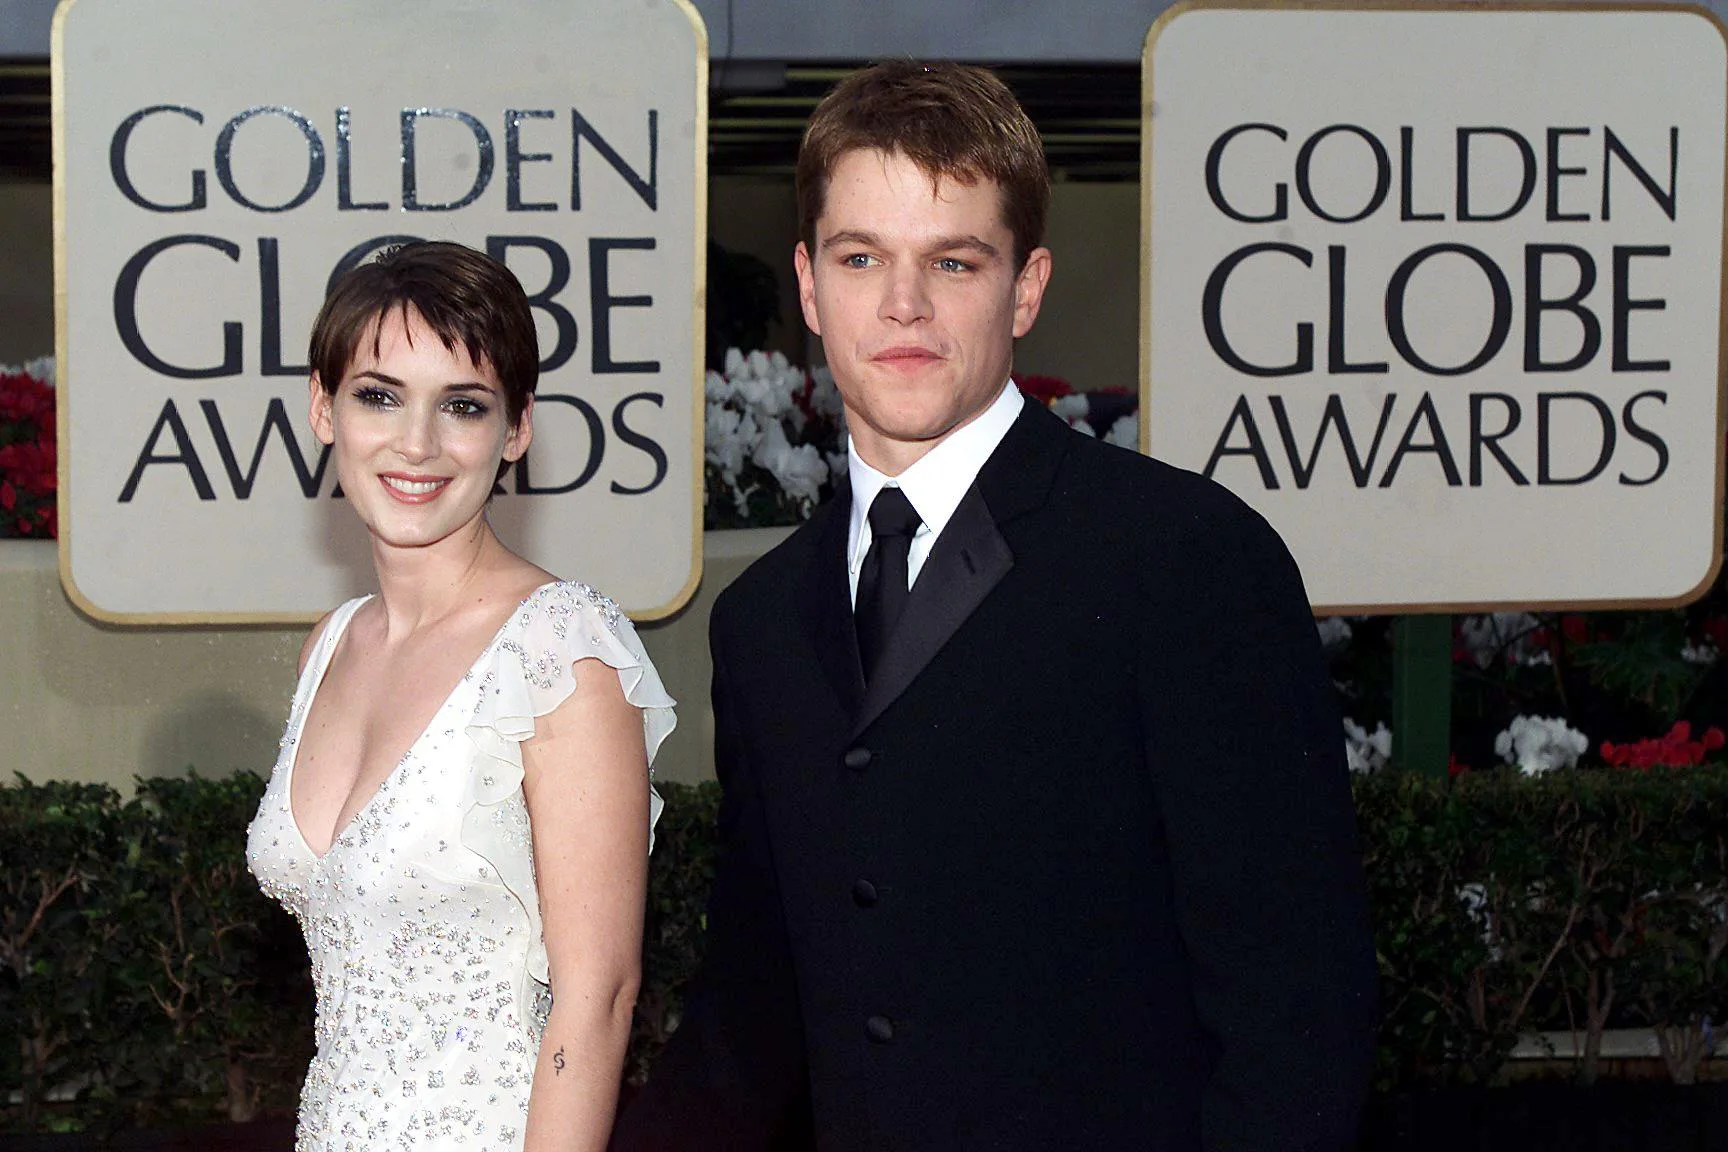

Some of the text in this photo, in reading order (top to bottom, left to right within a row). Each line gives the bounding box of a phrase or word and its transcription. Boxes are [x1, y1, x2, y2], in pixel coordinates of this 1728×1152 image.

[109, 104, 659, 213] GOLDEN
[1204, 122, 1679, 224] GOLDEN
[113, 234, 661, 379] GLBE
[1201, 241, 1671, 378] GLOBE
[117, 391, 669, 503] AWDS
[1201, 389, 1670, 490] AWARDS
